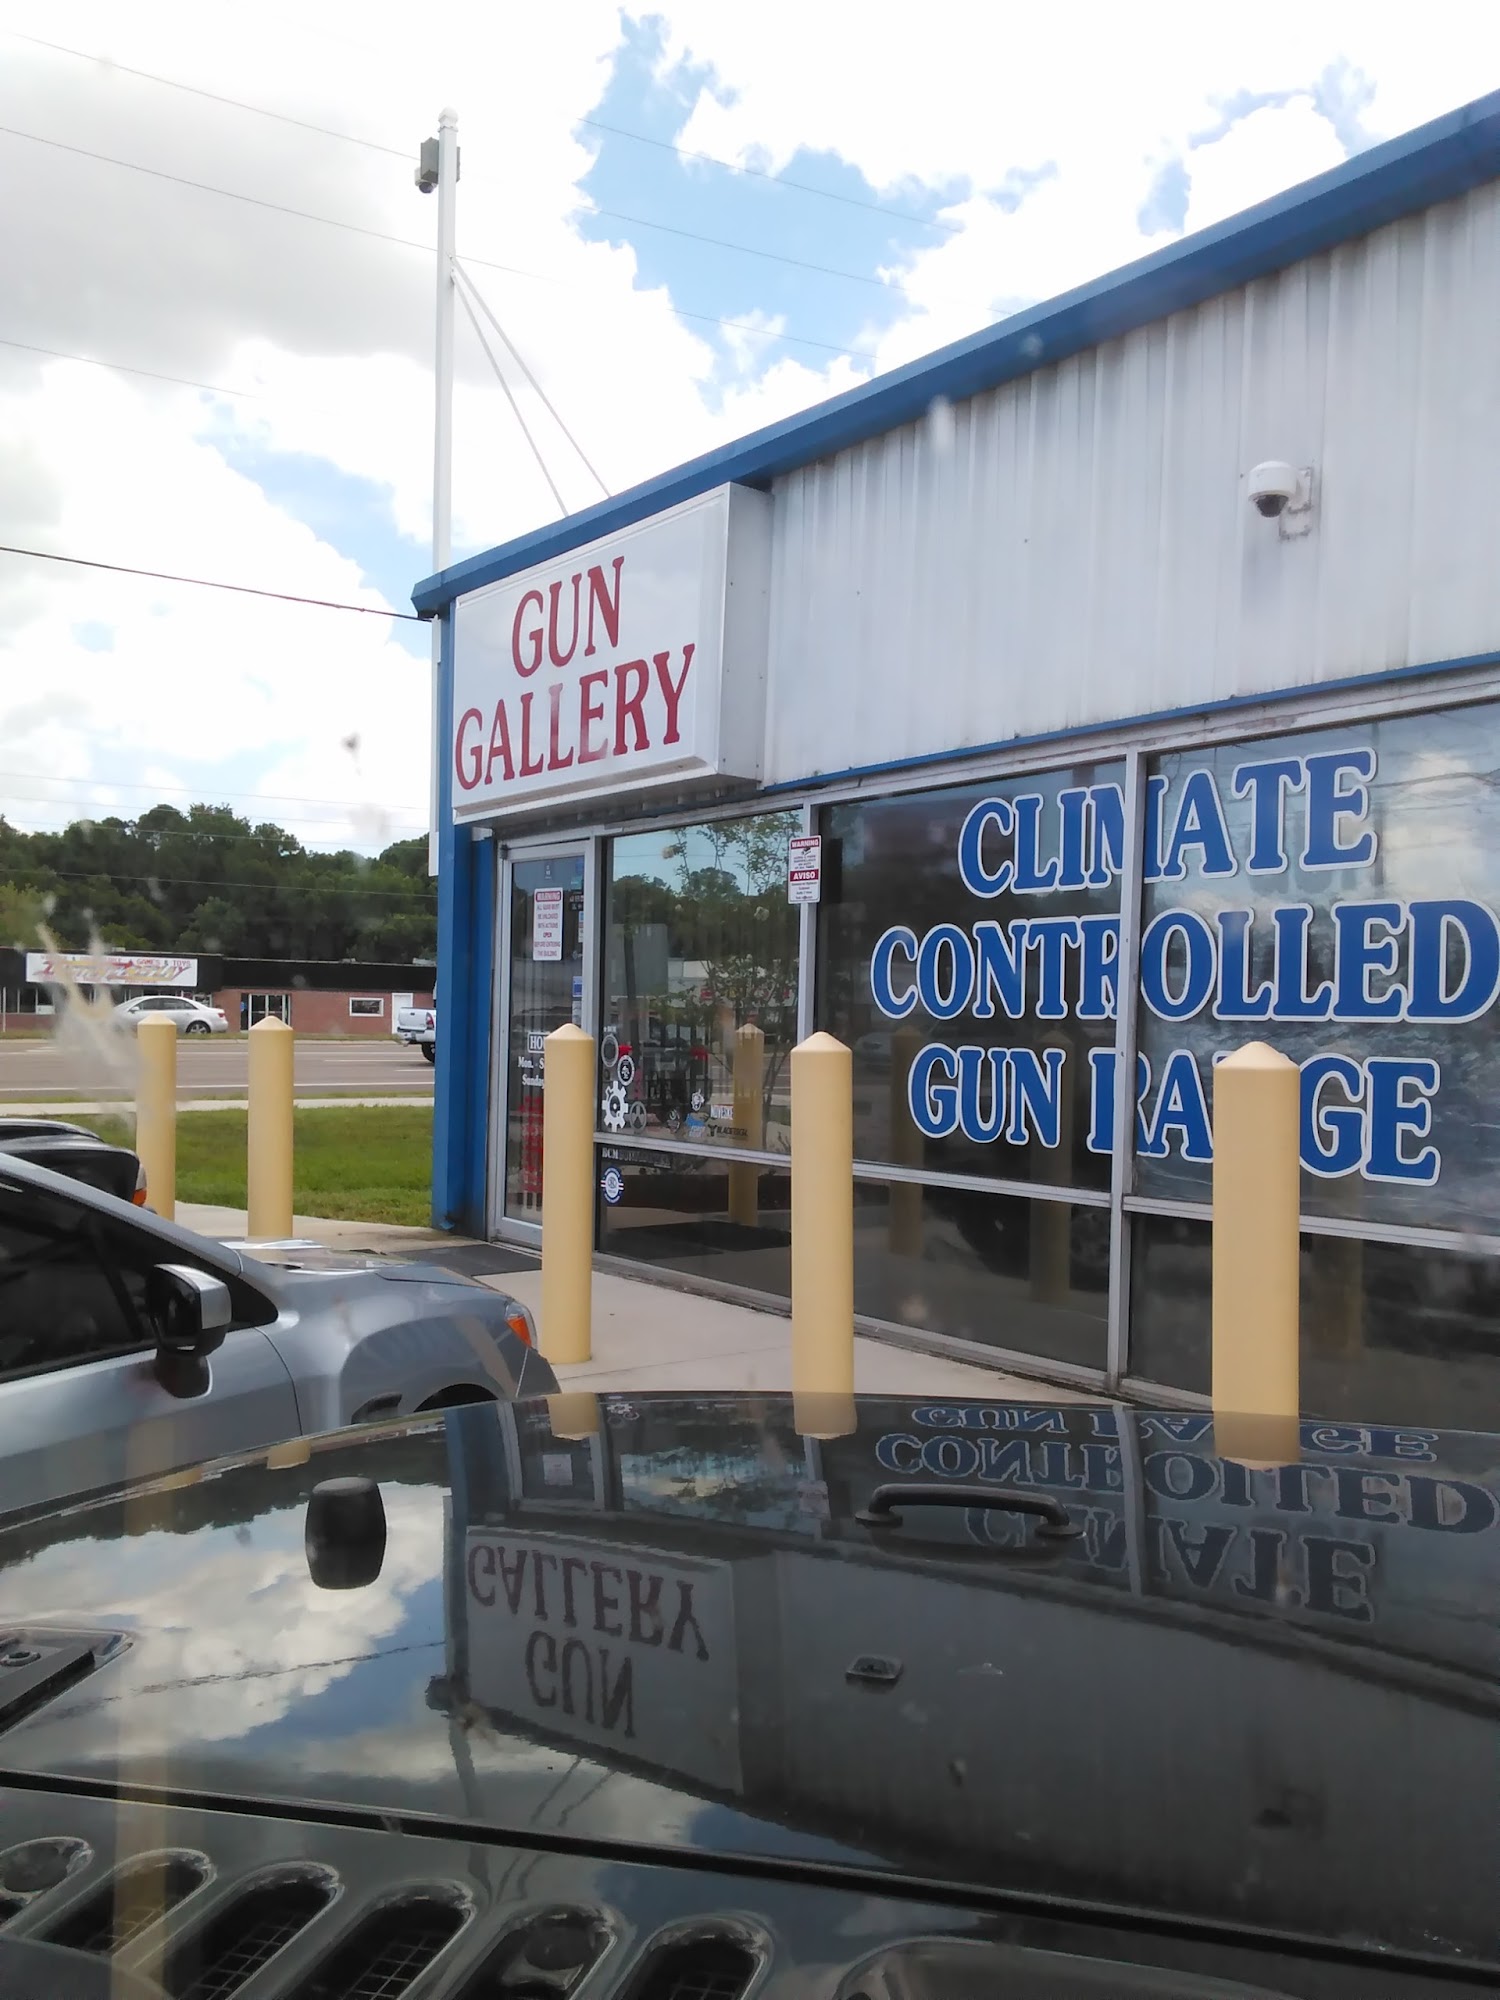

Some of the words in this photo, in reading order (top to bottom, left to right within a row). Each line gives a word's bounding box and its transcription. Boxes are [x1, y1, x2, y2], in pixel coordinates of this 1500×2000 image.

[512, 556, 624, 678] GUN
[455, 643, 695, 790] GALLERY
[791, 839, 819, 848] WARNING
[793, 871, 816, 880] AVISO
[958, 747, 1378, 898] CLIMATE
[871, 900, 1500, 1023] CONTROLLED
[908, 1042, 1065, 1148] GUN
[1087, 1049, 1441, 1186] RAGE
